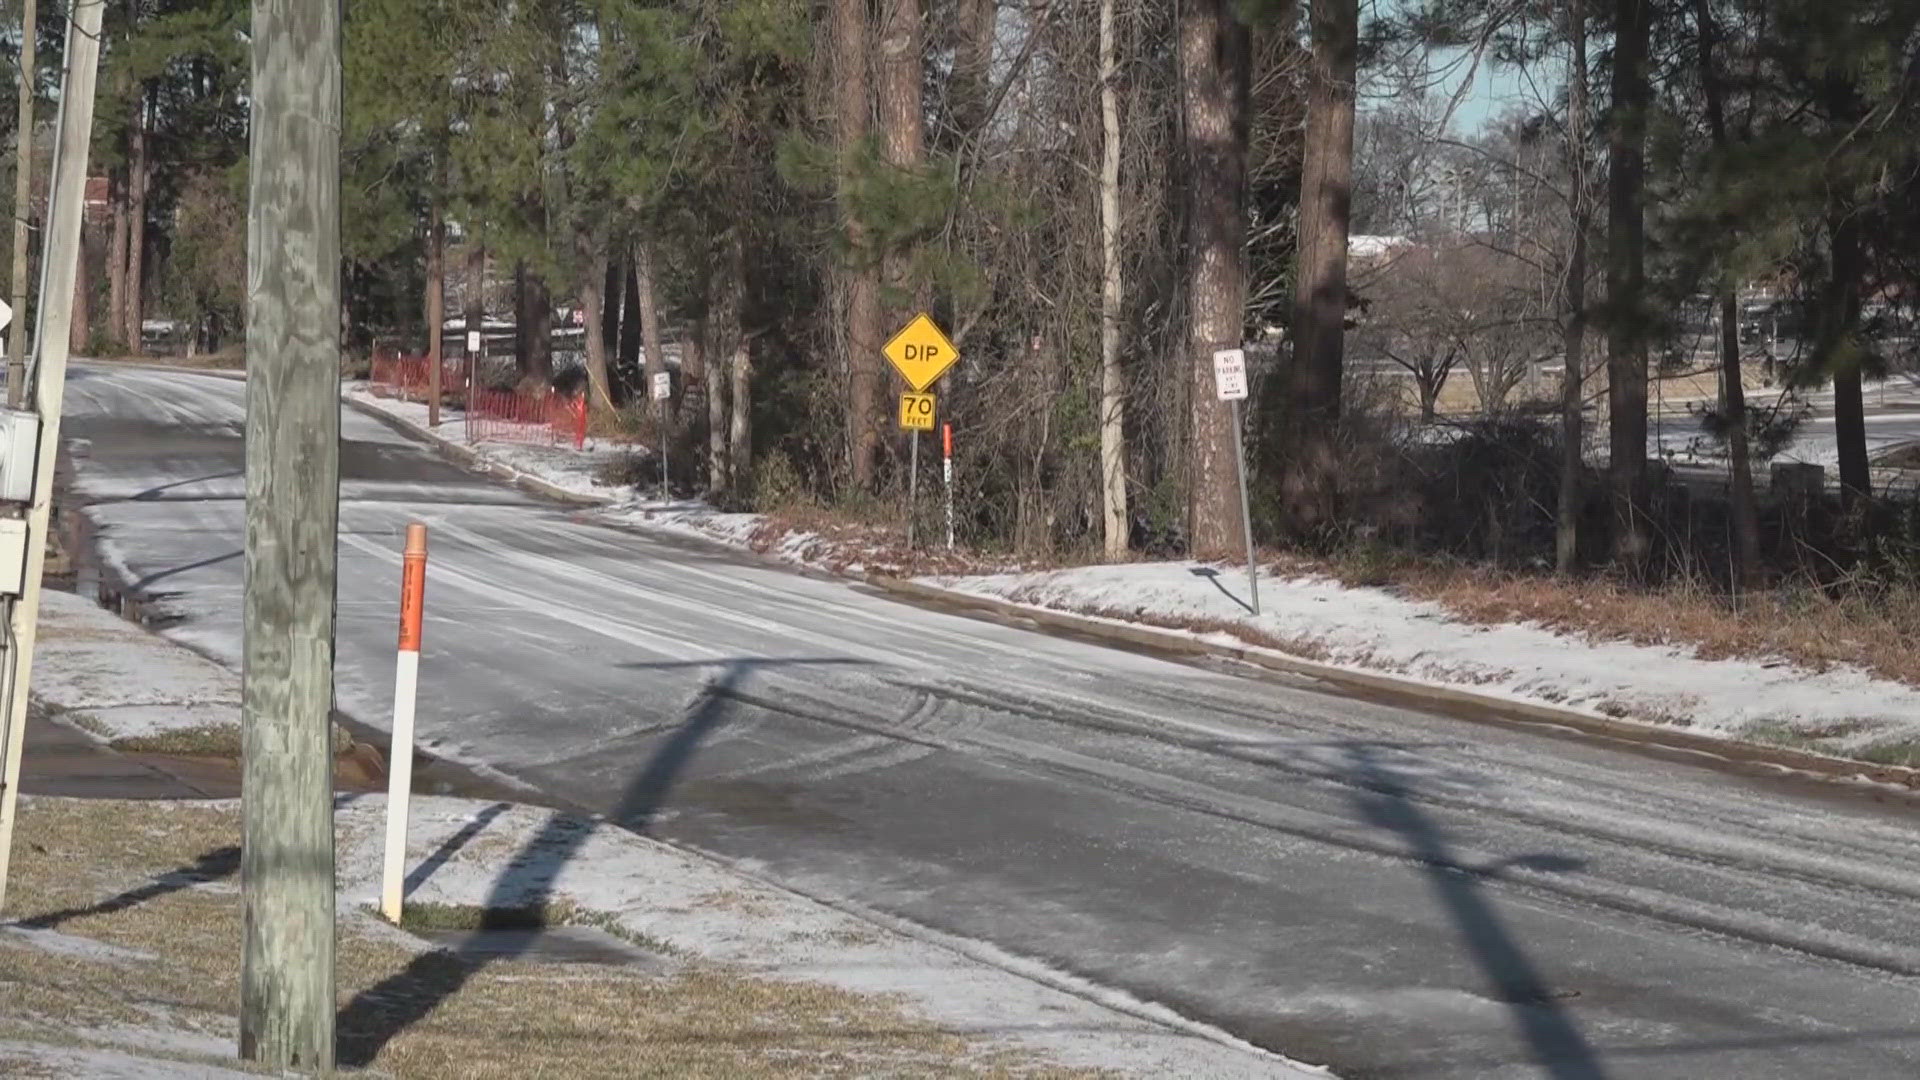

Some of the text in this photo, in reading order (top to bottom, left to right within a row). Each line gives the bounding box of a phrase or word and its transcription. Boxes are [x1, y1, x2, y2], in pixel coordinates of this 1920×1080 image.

[904, 344, 939, 362] DIP
[1223, 355, 1235, 365] NO
[903, 397, 932, 416] 70
[906, 416, 928, 426] FEET
